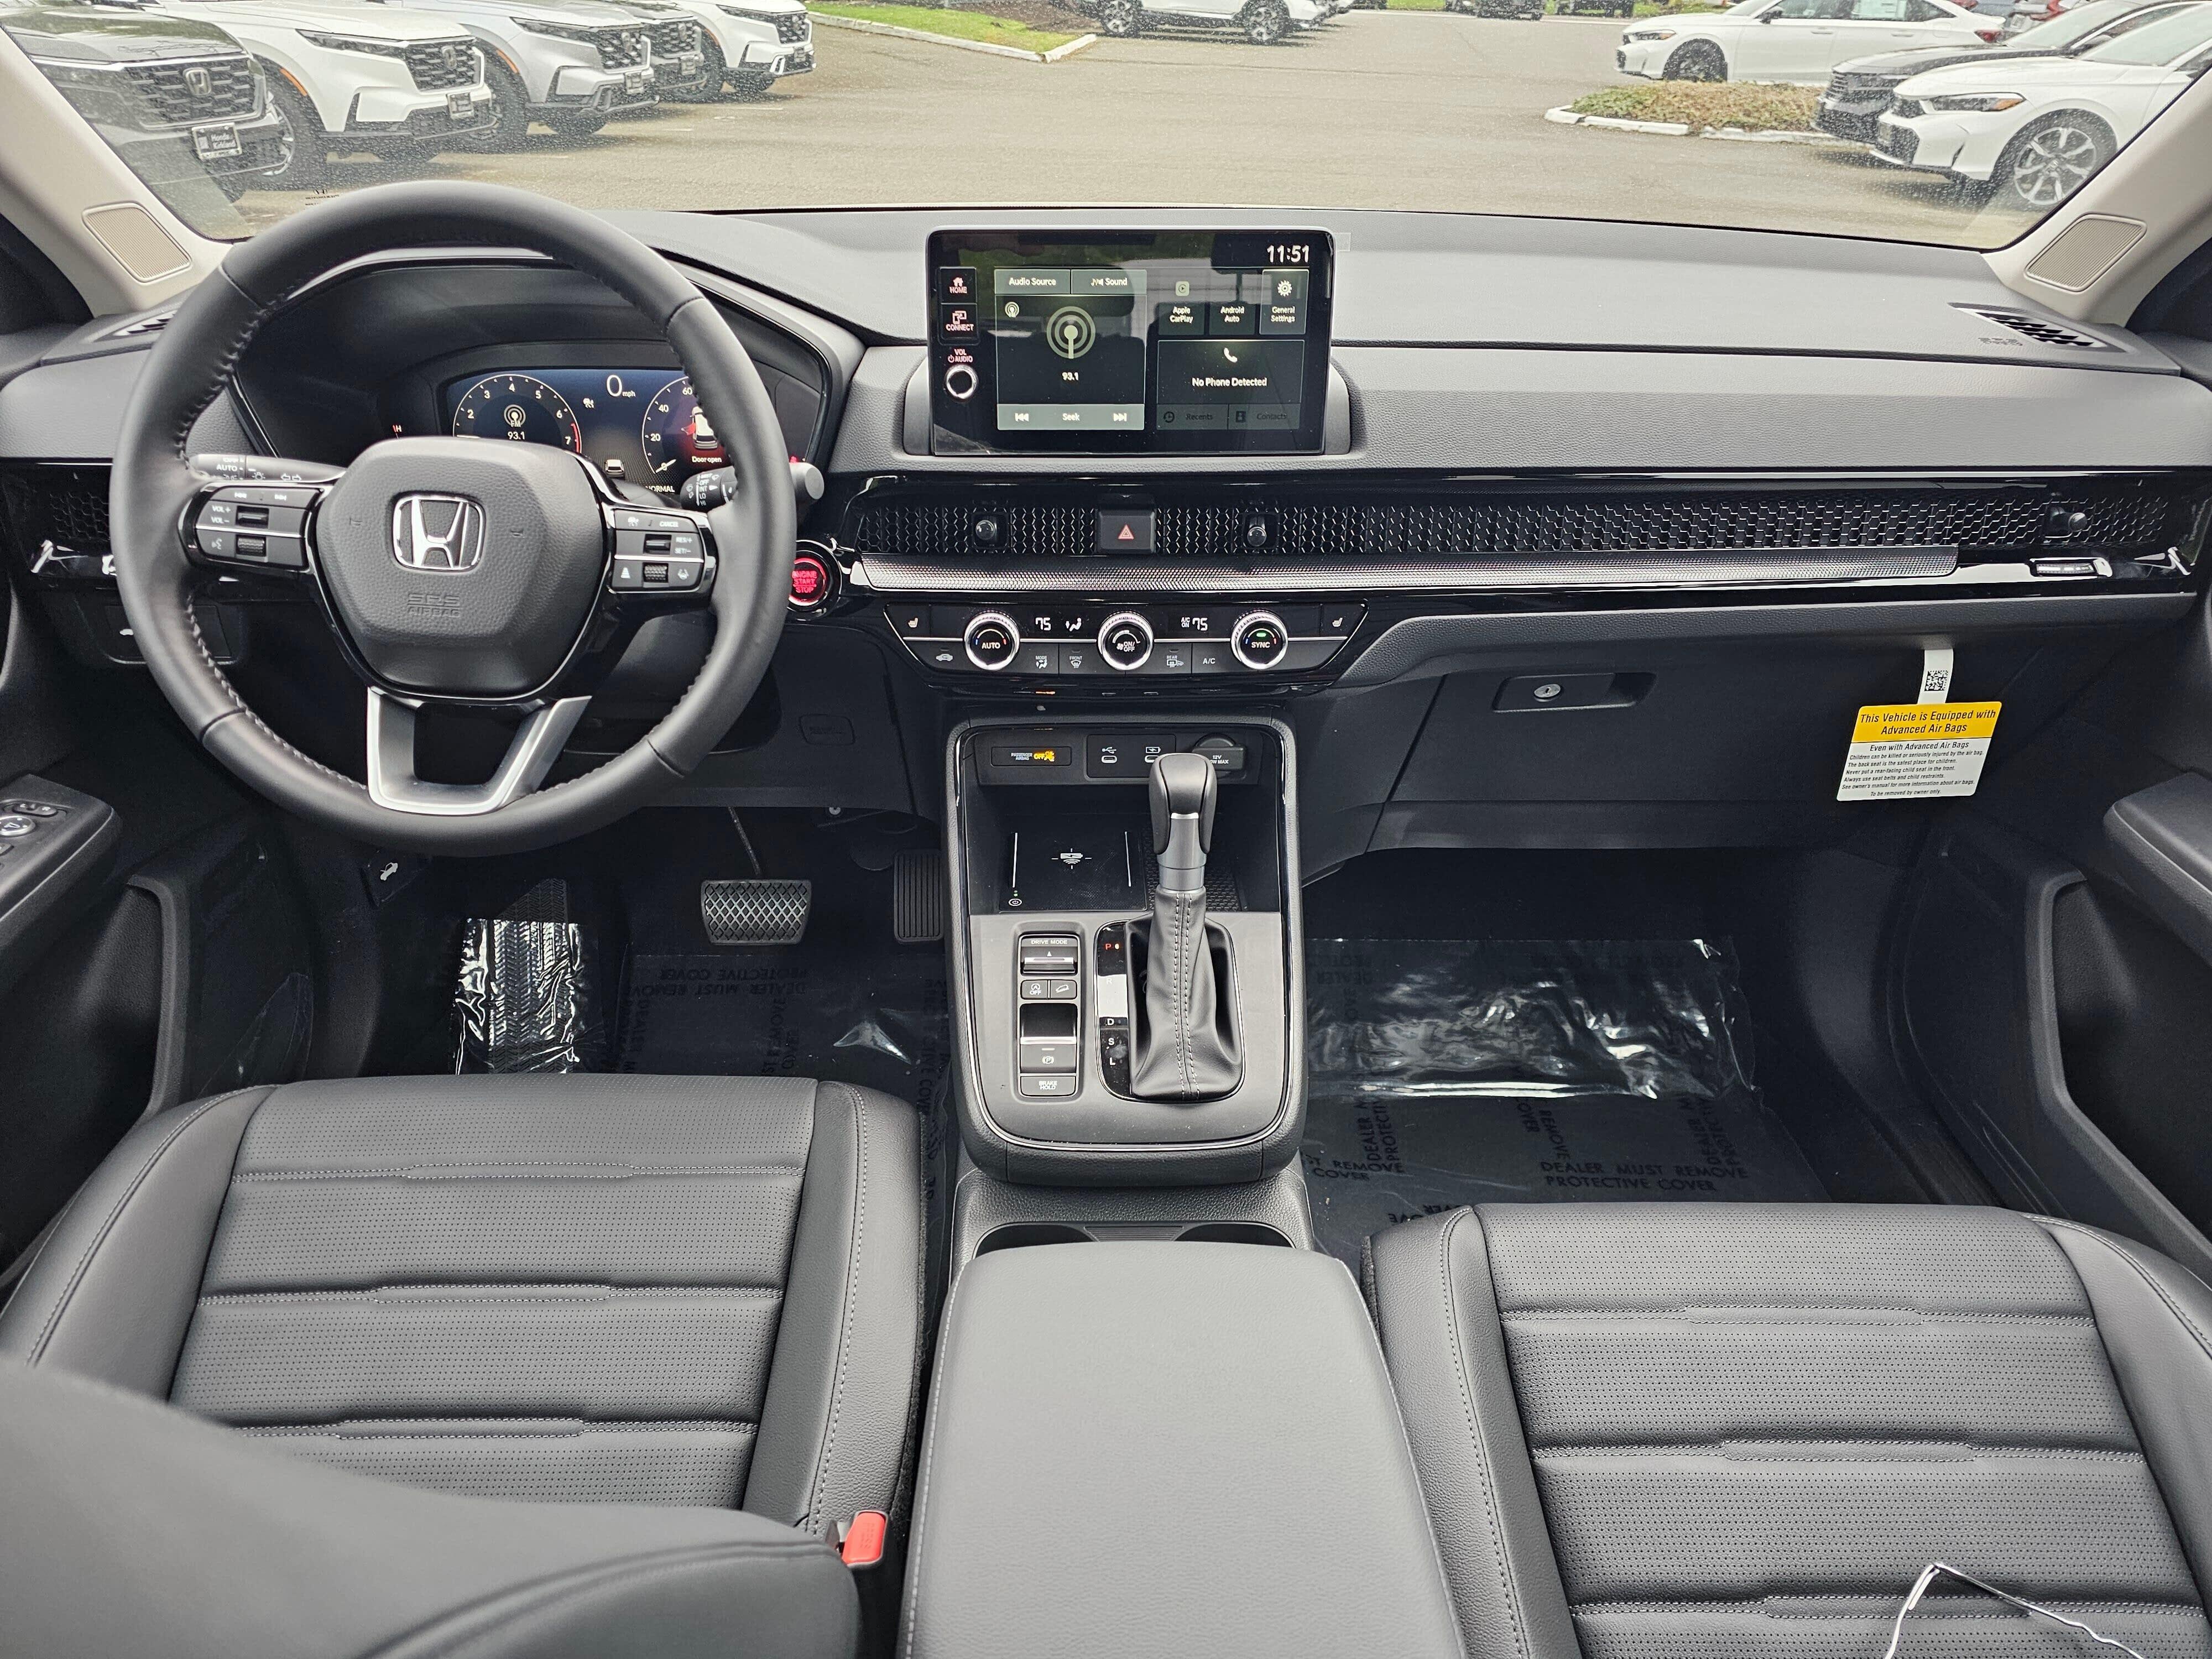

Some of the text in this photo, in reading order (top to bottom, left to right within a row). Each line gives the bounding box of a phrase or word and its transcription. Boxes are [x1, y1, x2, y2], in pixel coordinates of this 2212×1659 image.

[1267, 245, 1310, 263] 11:51
[1009, 277, 1056, 286] Audio Source
[1105, 278, 1128, 286] Sound
[1172, 306, 1191, 315] Apple
[1170, 315, 1193, 324] CarPlay
[1271, 315, 1295, 324] Settings
[1062, 372, 1079, 381] 93.1
[606, 374, 623, 397] 0
[1192, 377, 1267, 387] No Phone Detected
[508, 383, 516, 392] 4
[484, 390, 491, 399] 3
[535, 390, 542, 399] 5
[658, 404, 669, 413] 40
[467, 409, 475, 419] 2
[556, 410, 563, 419] 6
[1062, 412, 1080, 421] Seek
[1186, 413, 1213, 421] Recents
[1256, 412, 1287, 421] Contacts
[507, 431, 525, 440] 93.1
[650, 433, 661, 442] 20
[564, 436, 571, 445] 7
[1035, 617, 1051, 631] 75
[1192, 617, 1208, 631] 75
[1860, 709, 1996, 723] This Vehicle is Equipped with
[1881, 723, 1968, 734] Advanced Air Bags
[1108, 1037, 1115, 1046] S
[1109, 1057, 1116, 1066] L
[1356, 1117, 1381, 1161] DEALER
[1538, 1109, 1571, 1160] REMOVE
[1333, 1160, 1406, 1173] REMOVE
[1540, 1162, 1751, 1179] DEALER MUST REMOVE
[1313, 1168, 1370, 1181] COVER
[1546, 1176, 1718, 1192] PROTECTIVE COVER
